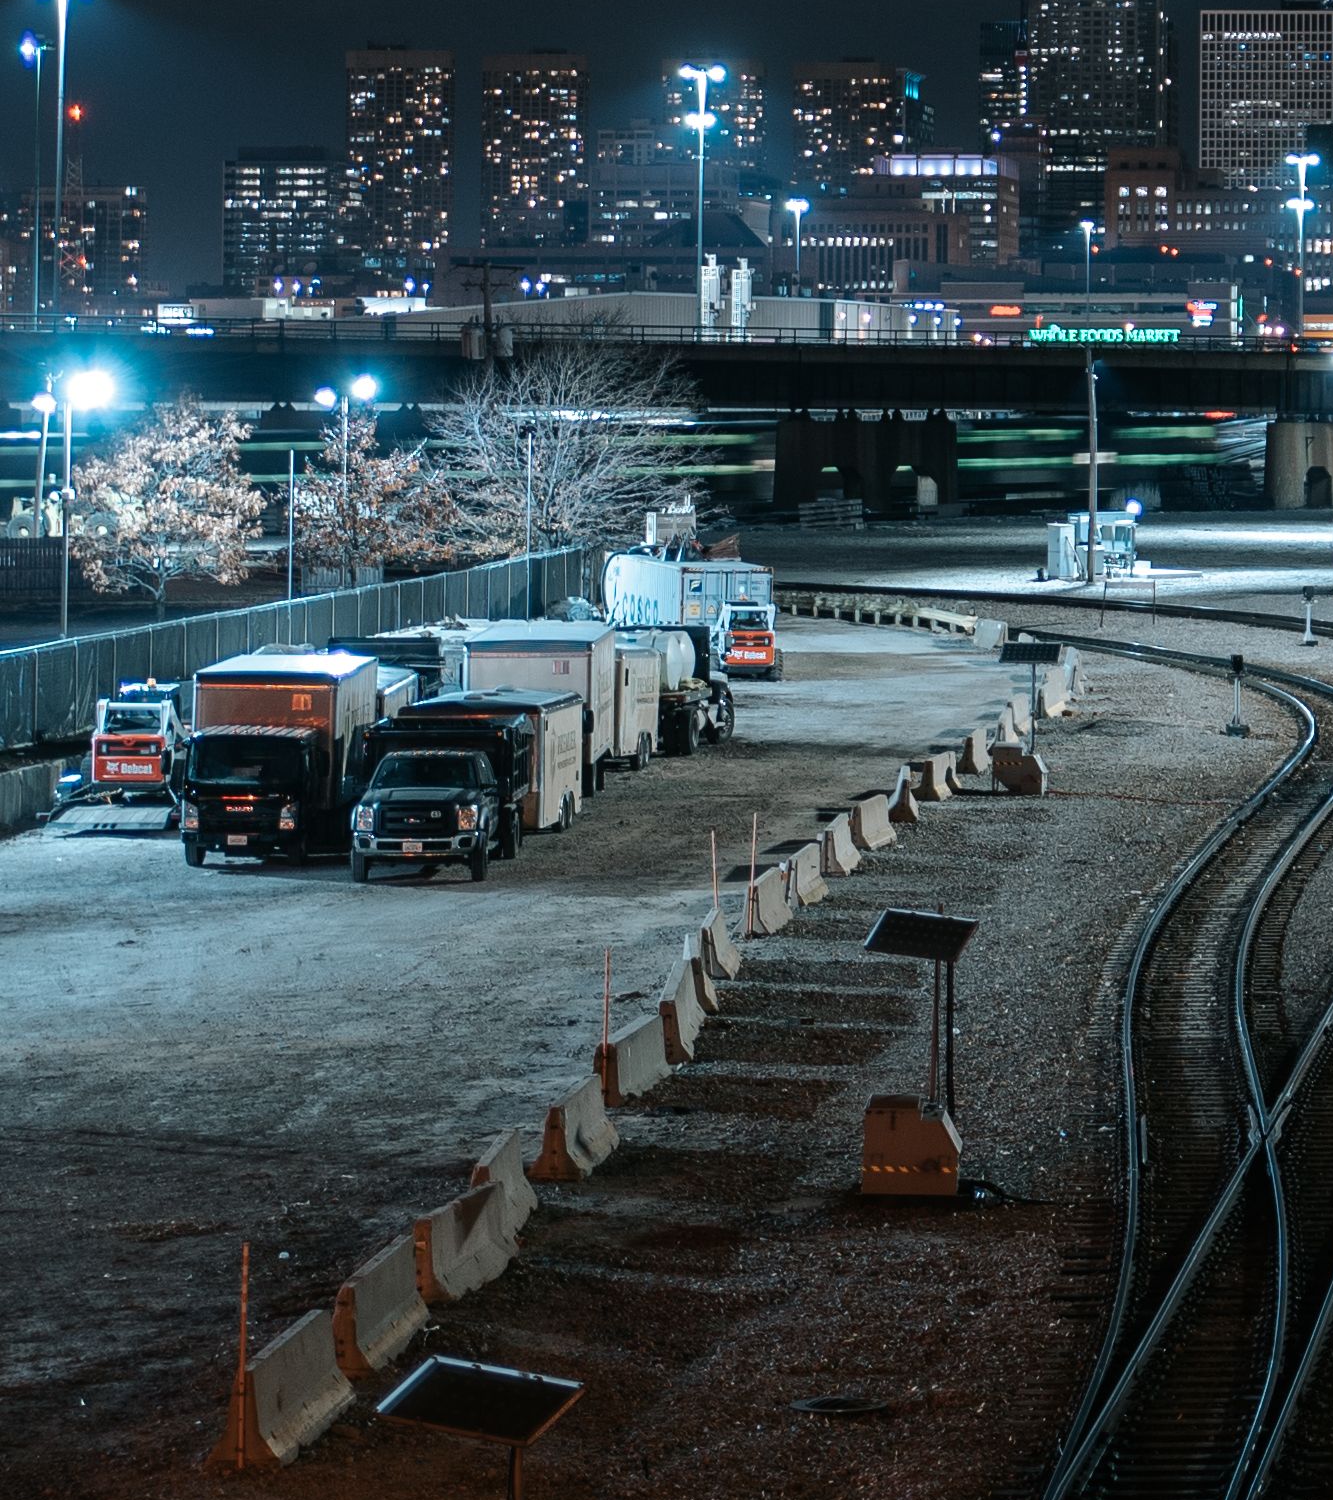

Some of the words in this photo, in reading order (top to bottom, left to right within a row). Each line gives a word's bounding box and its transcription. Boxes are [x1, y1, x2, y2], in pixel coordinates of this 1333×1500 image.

[1029, 328, 1077, 343] WHOLE
[1078, 328, 1124, 343] FOODS
[1126, 328, 1181, 343] MARKET
[622, 593, 659, 625] COSCO
[120, 762, 153, 774] Bobcat
